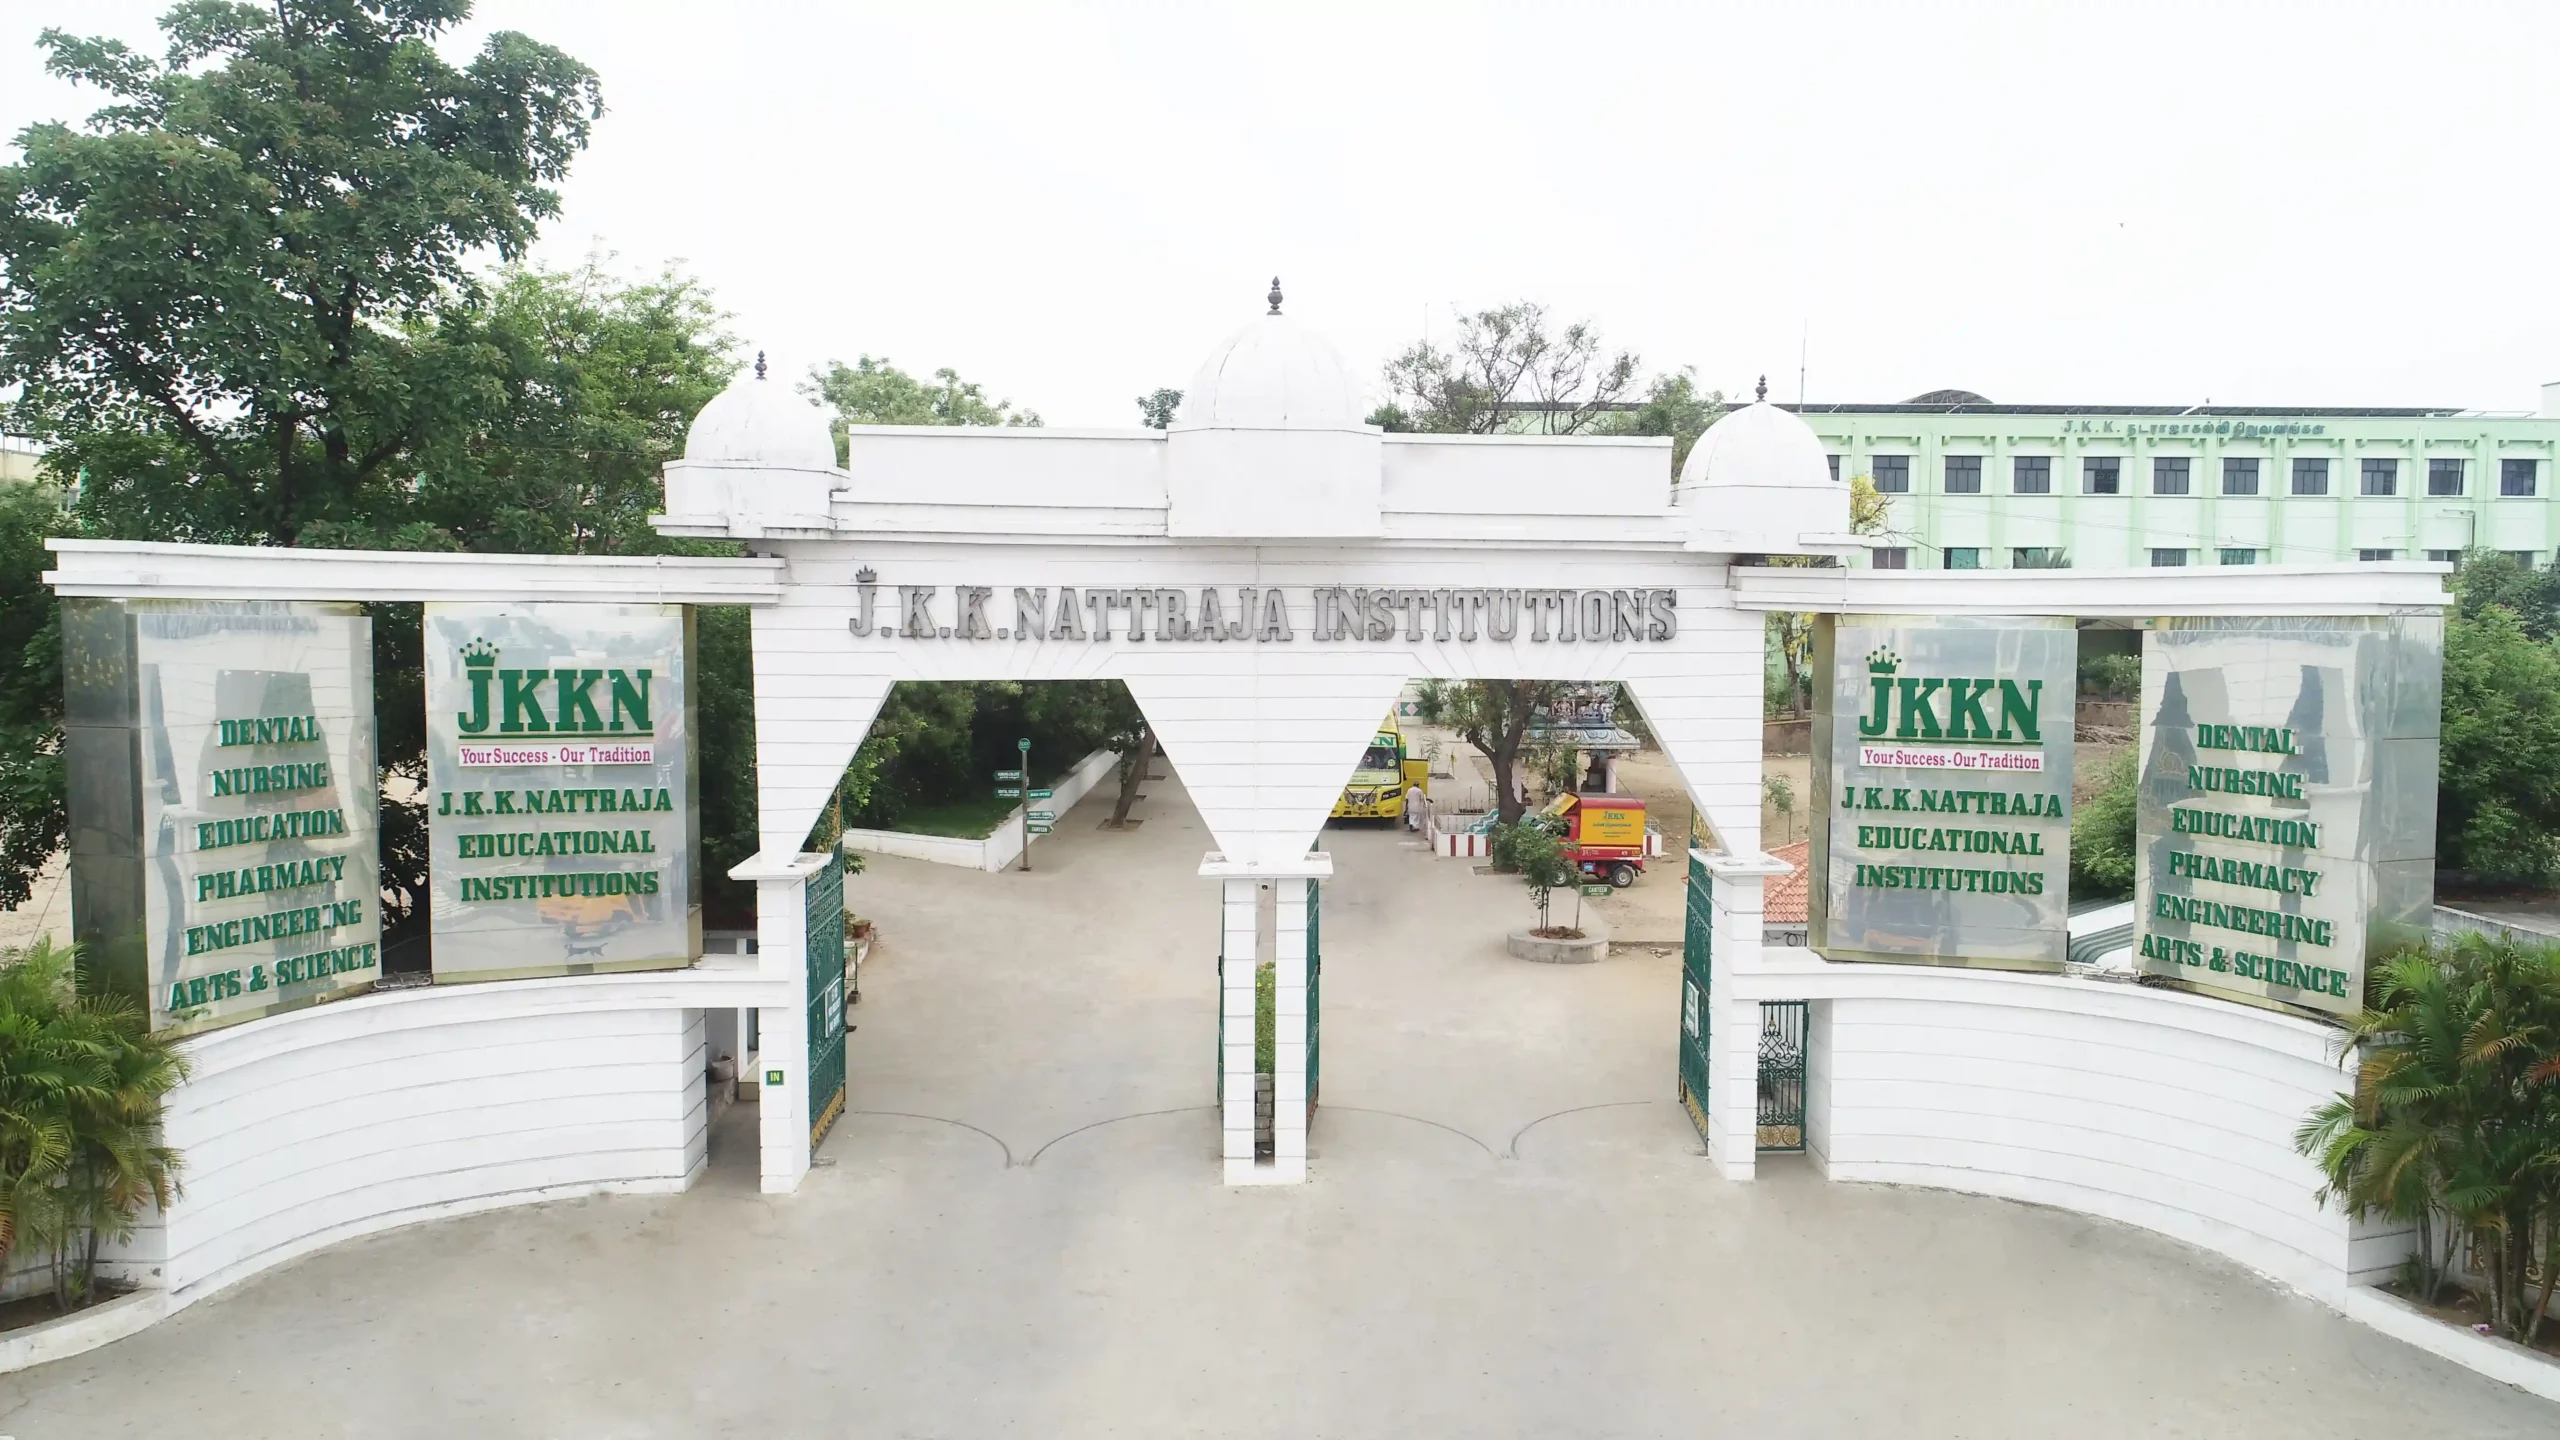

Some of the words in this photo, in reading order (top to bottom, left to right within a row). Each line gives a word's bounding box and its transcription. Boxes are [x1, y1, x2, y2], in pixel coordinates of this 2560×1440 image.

[1313, 587, 1677, 642] INSTITUTIONS
[458, 669, 653, 733] JKKN
[1859, 677, 2043, 740] JKKN
[217, 715, 319, 747] DENTAL
[2197, 723, 2300, 755] DENTAL
[461, 748, 492, 764] Your
[494, 748, 548, 763] Success
[560, 747, 585, 762] Our
[589, 746, 651, 763] Tradition
[1865, 749, 1894, 765] Your
[1896, 750, 1945, 766] Success
[1953, 752, 1977, 767] Our
[1979, 753, 2040, 769] Tradition
[210, 762, 327, 797] NURSING
[2188, 765, 2307, 800] NURSING
[438, 788, 673, 816] J.K.K.NATTRAJA
[1841, 786, 2063, 818] J.K.K.NATTRAJA
[197, 808, 343, 850] EDUCATION
[458, 830, 655, 859] EDUCATIONAL
[1857, 825, 2044, 856] EDUCATIONAL
[2172, 807, 2320, 849] EDUCATION
[194, 855, 347, 901] PHARMACY
[461, 871, 659, 901] INSTITUTIONS
[1856, 864, 2044, 895] INSTITUTIONS
[2169, 850, 2321, 897] PHARMACY
[2156, 893, 2334, 947] ENGINEERING
[169, 968, 241, 1012] ARTS
[248, 964, 268, 993] &
[275, 943, 376, 987] SCIENCE
[2140, 933, 2203, 967] ARTS
[2209, 947, 2231, 973] &
[2234, 950, 2350, 998] SCIENCE
[770, 1072, 780, 1082] IN
